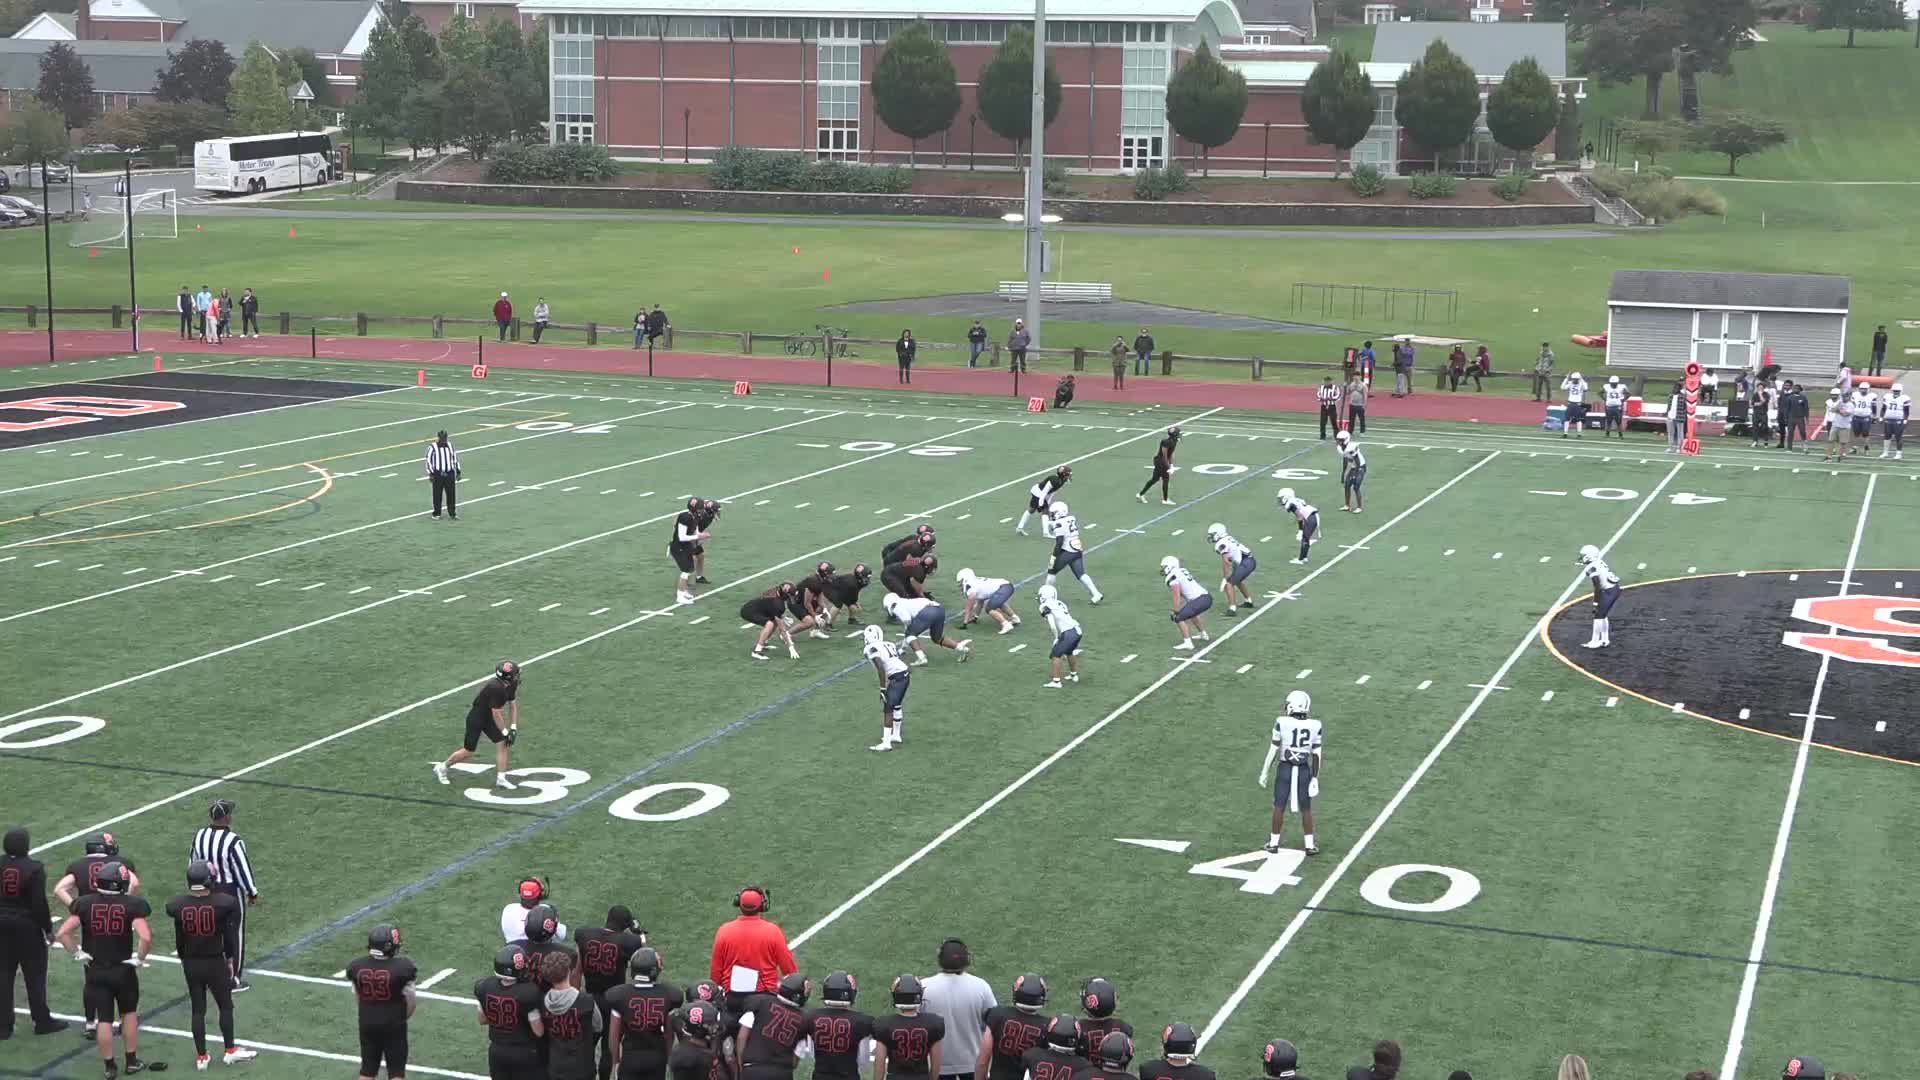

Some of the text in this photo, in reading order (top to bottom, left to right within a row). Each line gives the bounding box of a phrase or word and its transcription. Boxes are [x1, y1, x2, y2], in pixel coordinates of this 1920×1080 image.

[474, 367, 484, 377] G
[736, 382, 746, 393] 10
[1029, 399, 1041, 410] 20
[1290, 727, 1311, 748] 12
[91, 903, 126, 936] 56
[182, 906, 216, 936] 80
[584, 940, 618, 975] 23
[357, 968, 392, 1001] 63
[484, 993, 519, 1033] 58
[628, 997, 665, 1032] 35
[762, 1003, 801, 1047] 75
[815, 1016, 851, 1053] 28
[892, 1027, 929, 1061] 33
[998, 1019, 1041, 1056] 85
